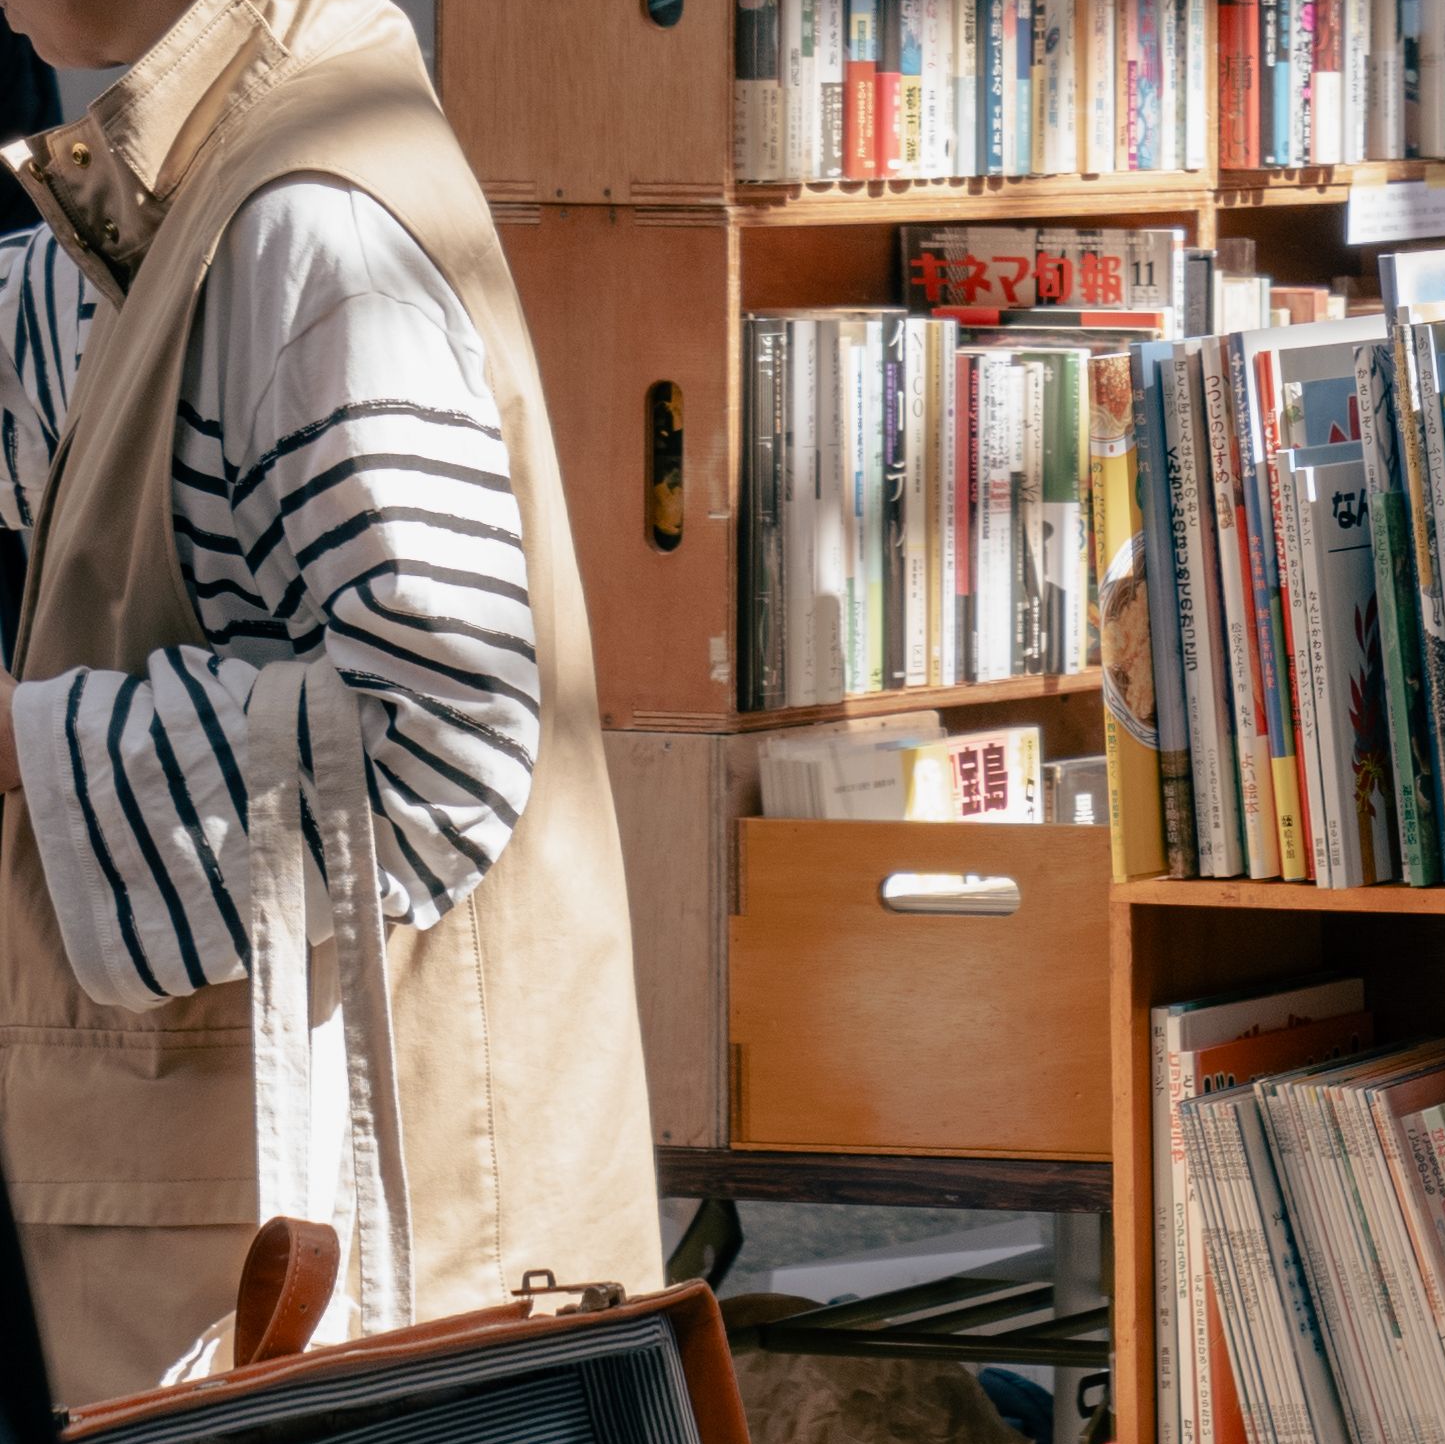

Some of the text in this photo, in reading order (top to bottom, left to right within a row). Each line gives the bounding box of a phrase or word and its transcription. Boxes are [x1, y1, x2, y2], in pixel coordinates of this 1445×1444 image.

[911, 252, 1157, 305] キネマ旬報 11
[1133, 388, 1151, 474] はるにれ
[1205, 374, 1230, 485] つつじのむすめ
[1356, 366, 1375, 446] かさじぞう
[1421, 369, 1437, 435] おちてくる
[1429, 442, 1445, 508] ふってくる
[1165, 444, 1200, 672] くんちゃんのはじめてのがっこう
[1282, 481, 1303, 609] わすれられない おくりもの
[1297, 649, 1314, 741] スーザン・バーレイ
[1308, 590, 1325, 701] なんにかわるかな?
